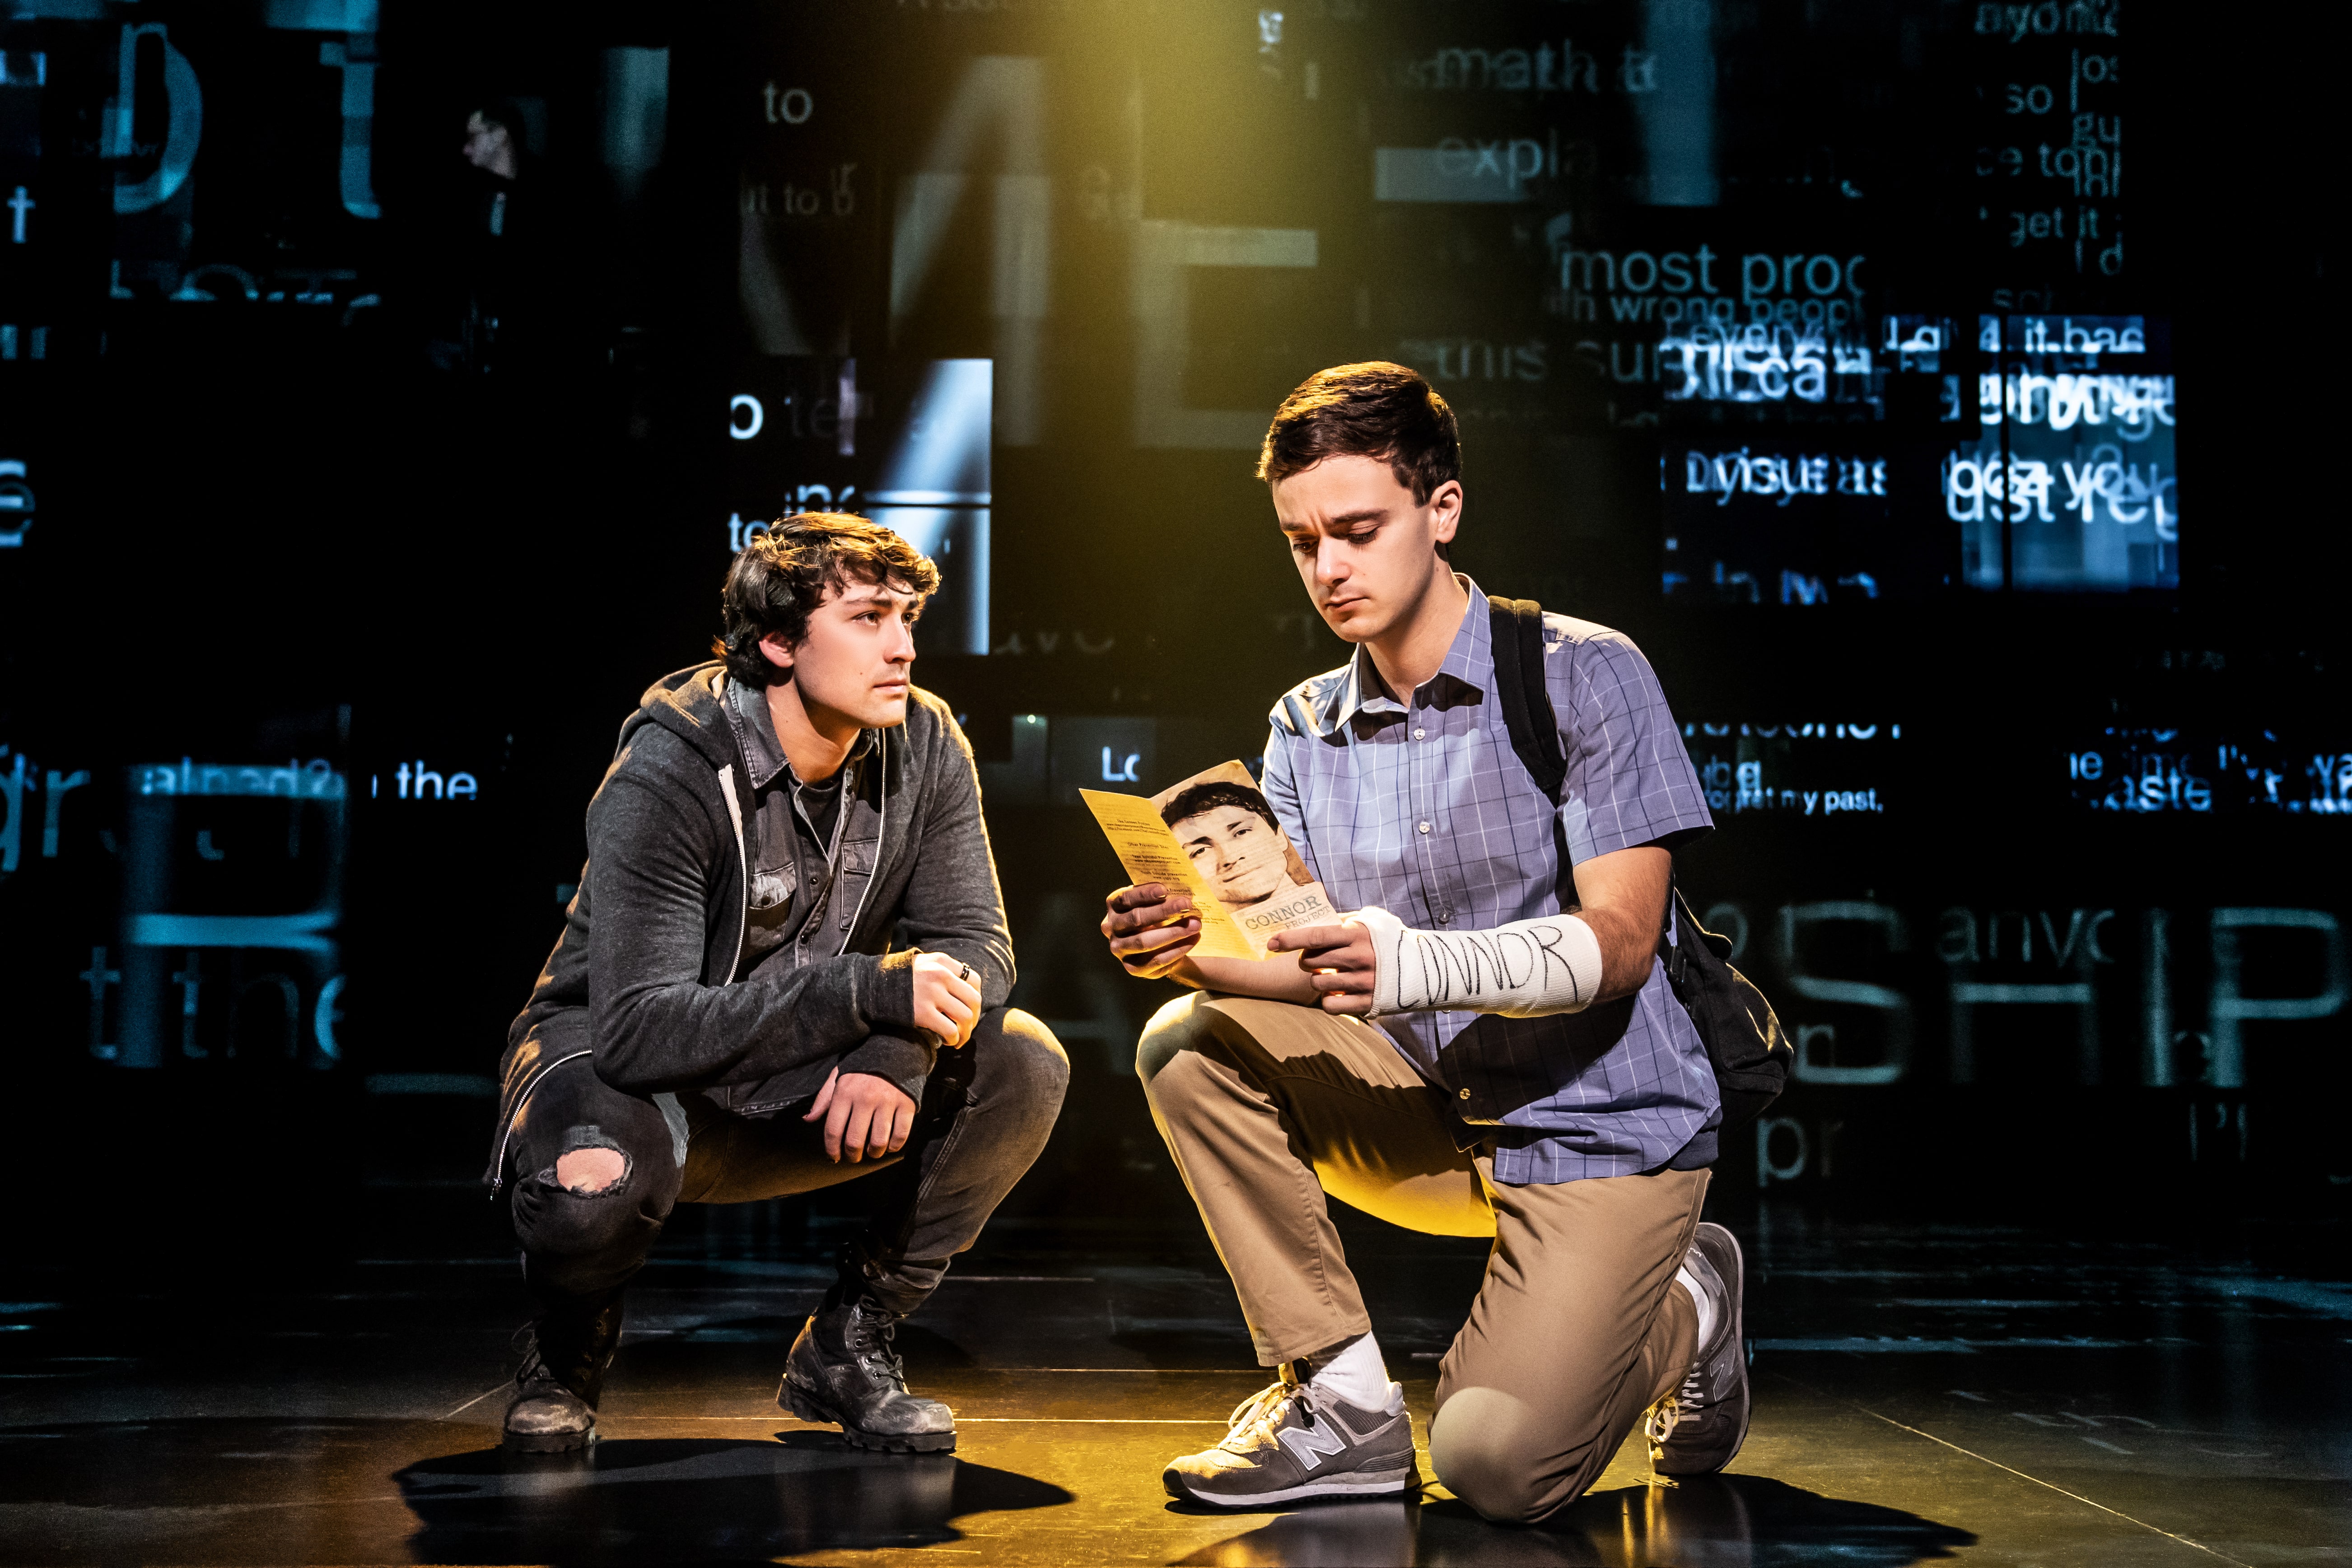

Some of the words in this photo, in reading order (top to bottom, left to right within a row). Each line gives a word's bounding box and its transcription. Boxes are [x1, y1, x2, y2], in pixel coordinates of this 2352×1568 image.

[761, 78, 813, 125] to
[1559, 242, 1719, 294] most
[395, 759, 479, 801] the
[1824, 787, 1884, 816] past,
[1245, 895, 1322, 930] CONNOR
[1284, 905, 1332, 930] PROJECT
